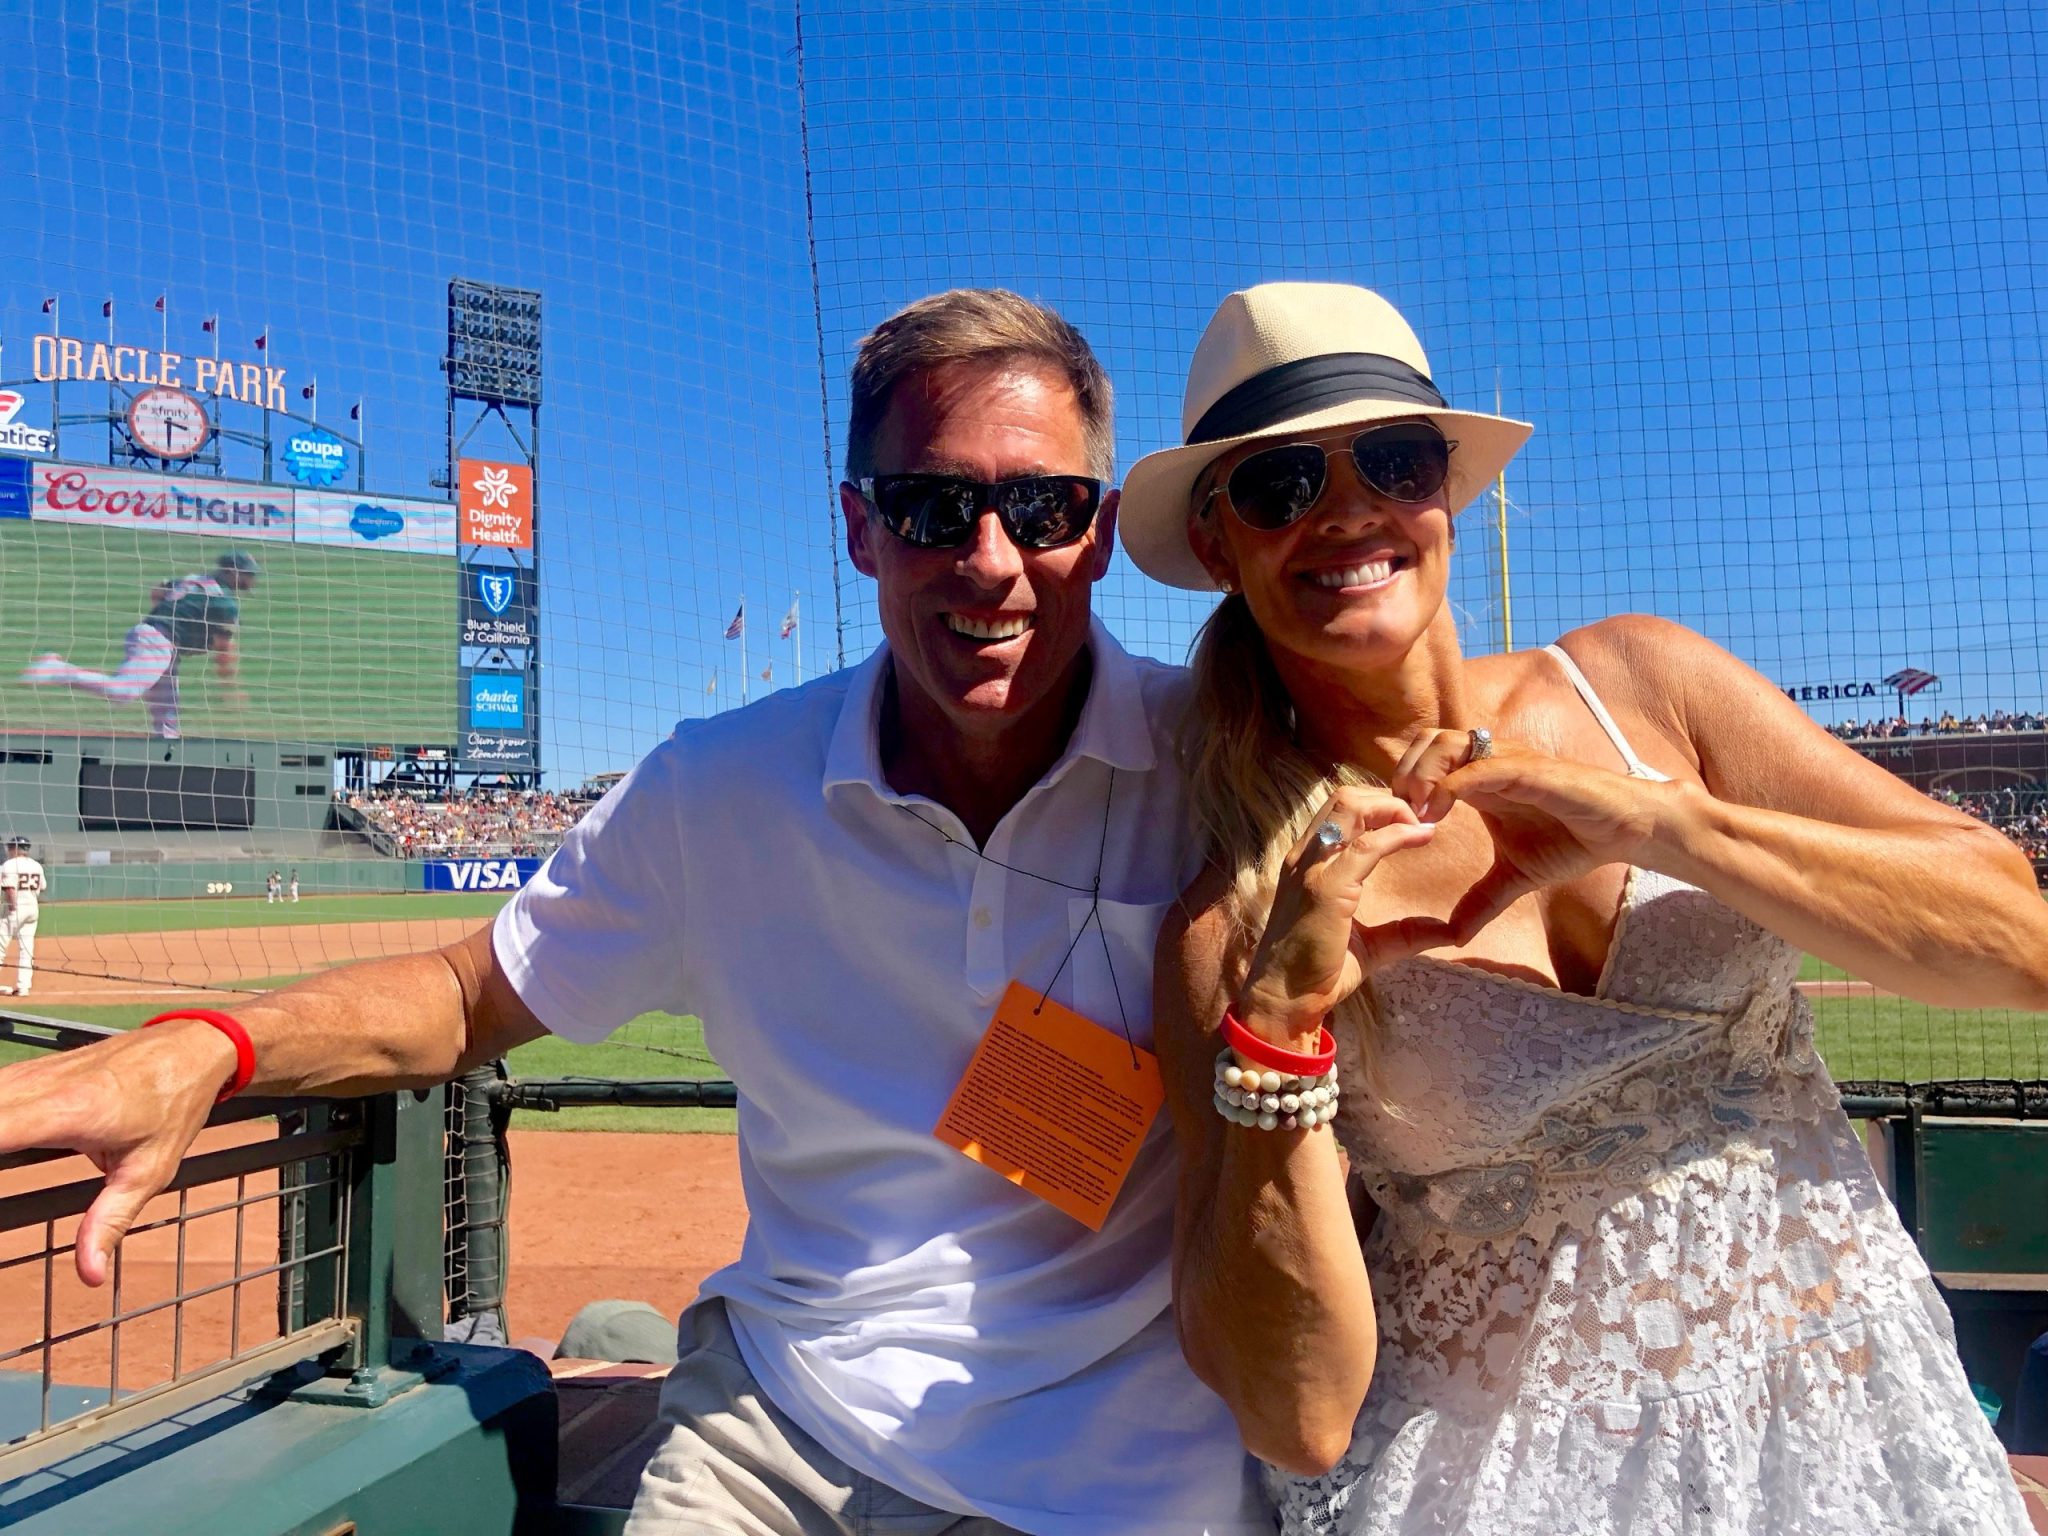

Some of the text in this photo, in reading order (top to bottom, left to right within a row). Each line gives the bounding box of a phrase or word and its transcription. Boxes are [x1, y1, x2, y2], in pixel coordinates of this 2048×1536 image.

[33, 334, 287, 414] ORACLE PARK
[151, 405, 189, 420] xfinity
[292, 438, 343, 461] coupa
[45, 472, 279, 527] Coors LIGHT
[469, 508, 522, 528] Dignity
[467, 619, 526, 633] Blue Shield
[463, 632, 531, 645] of California
[476, 689, 518, 703] charles
[1780, 682, 1876, 701] MERICA
[476, 703, 519, 713] SCHWAB
[19, 873, 40, 890] 23
[442, 862, 521, 889] VISA
